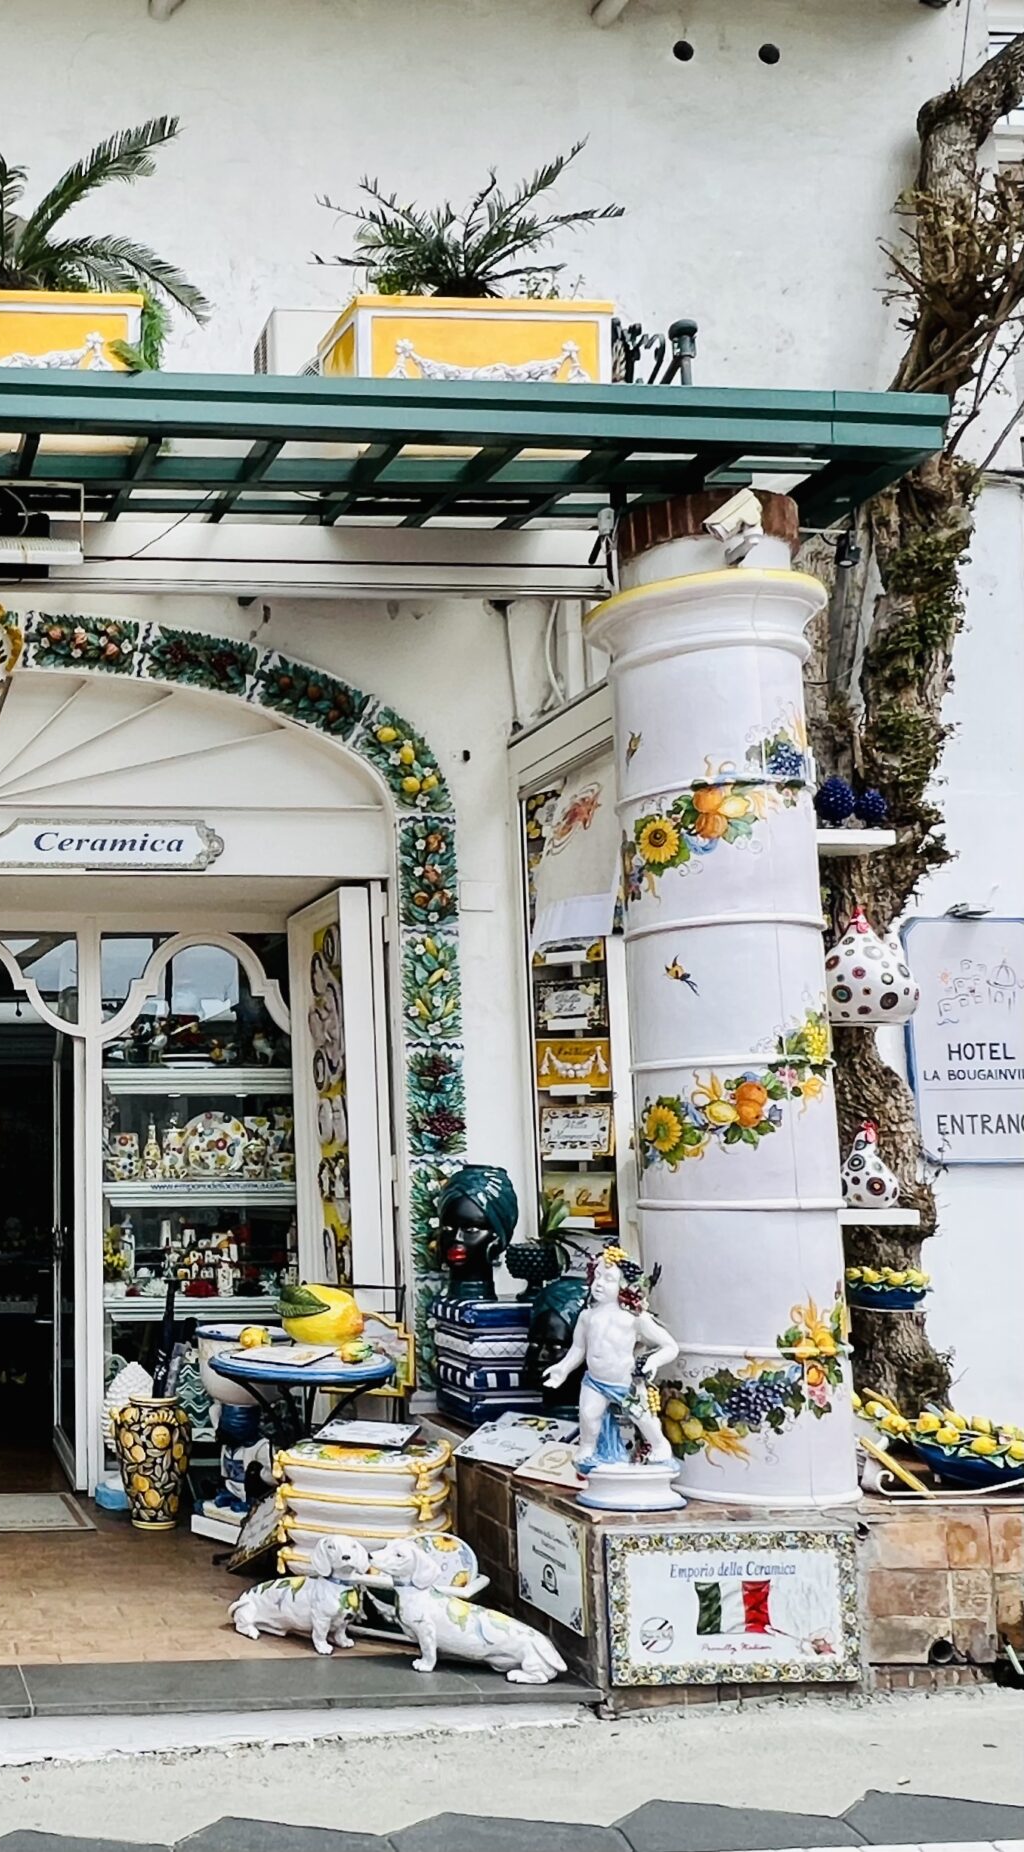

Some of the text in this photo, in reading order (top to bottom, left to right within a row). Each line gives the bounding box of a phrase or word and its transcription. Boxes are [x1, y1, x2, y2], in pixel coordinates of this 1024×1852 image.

[33, 831, 184, 854] Ceramica
[947, 1042, 1016, 1061] HOTEL
[923, 1069, 941, 1081] LA
[669, 1560, 796, 1582] Emporio della Ceramica
